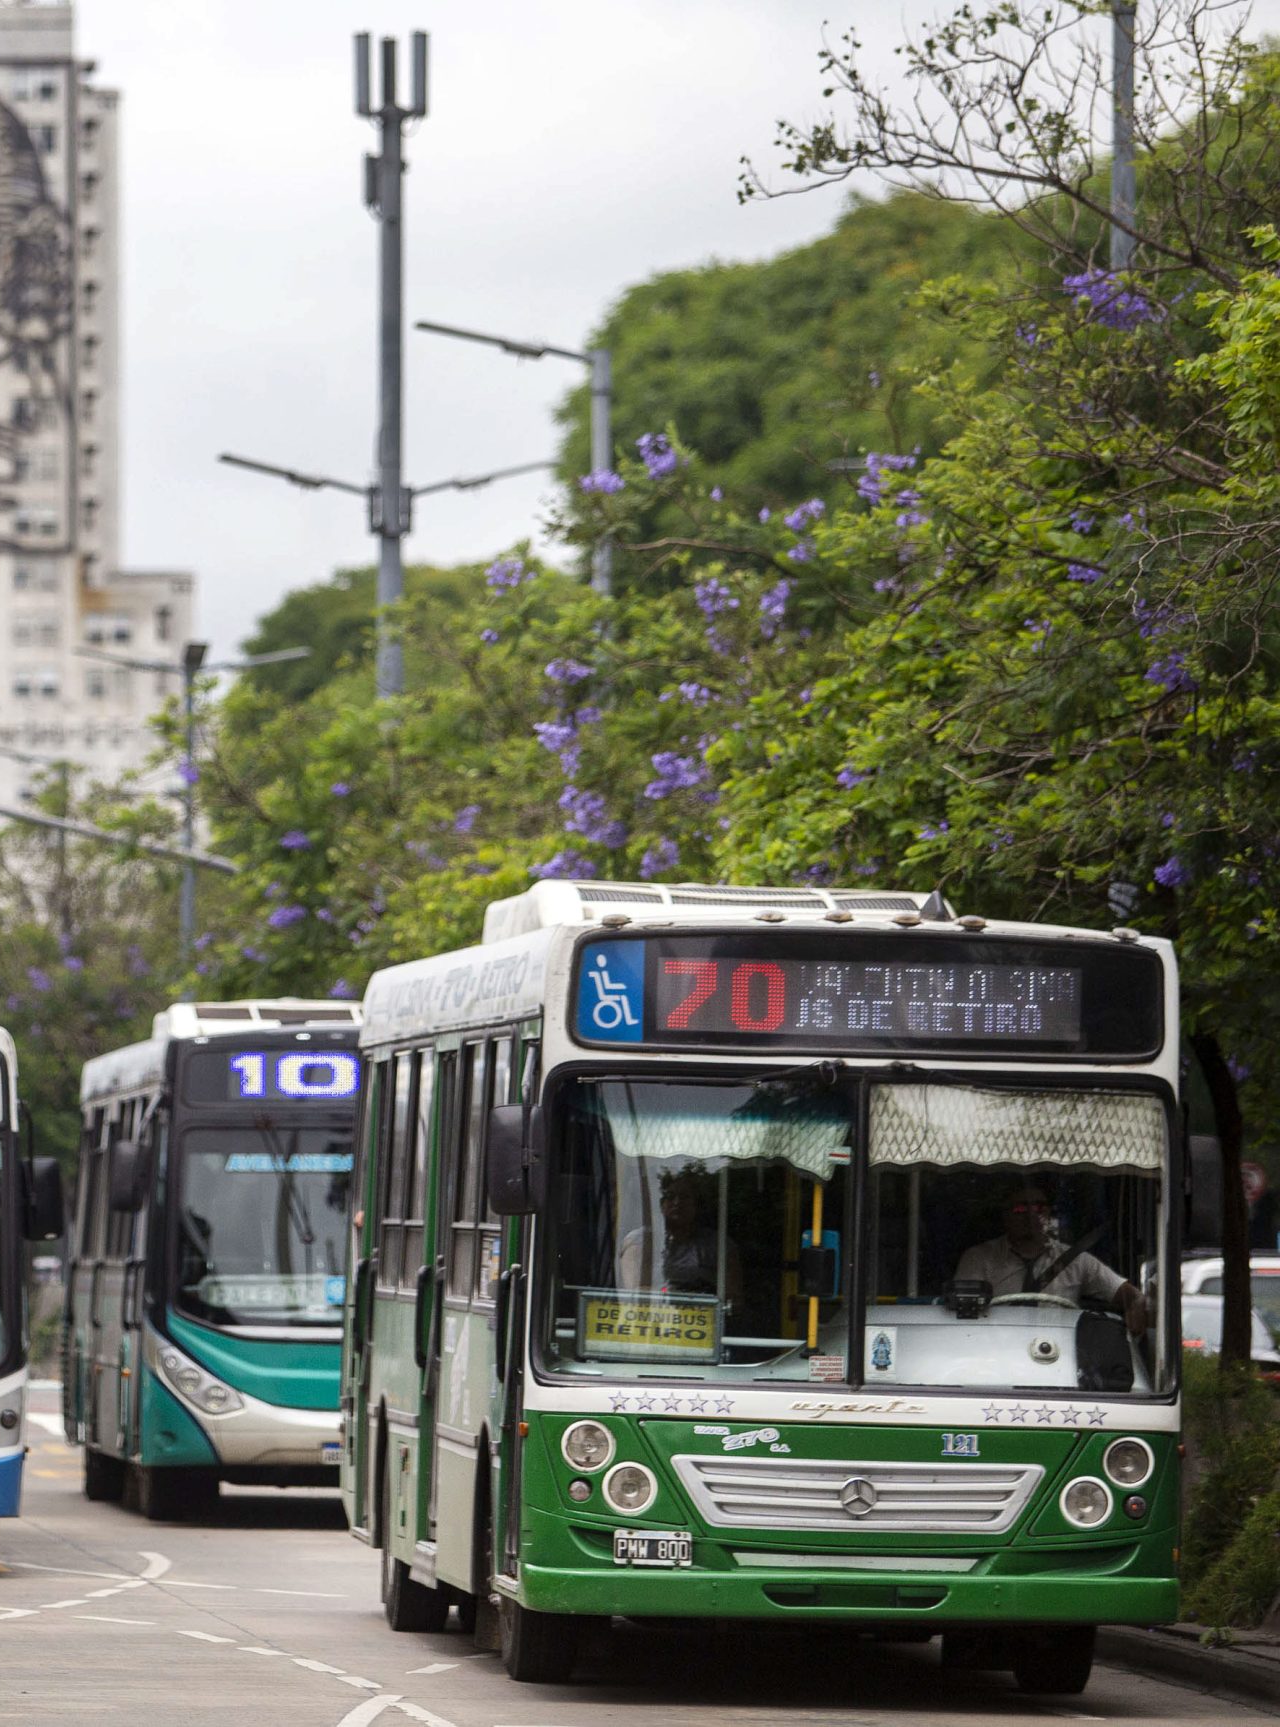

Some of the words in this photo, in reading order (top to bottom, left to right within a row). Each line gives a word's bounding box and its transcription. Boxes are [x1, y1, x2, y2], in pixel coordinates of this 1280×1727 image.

[663, 960, 786, 1032] 70
[847, 998, 894, 1031] DE
[907, 1001, 1042, 1035] RETIRO
[230, 1052, 360, 1098] 10
[596, 1308, 620, 1320] DE
[625, 1310, 707, 1327] OMNIBUS
[595, 1322, 707, 1340] RETIRO
[941, 1433, 980, 1456] 121
[617, 1538, 648, 1558] PMW
[657, 1540, 689, 1560] 800
